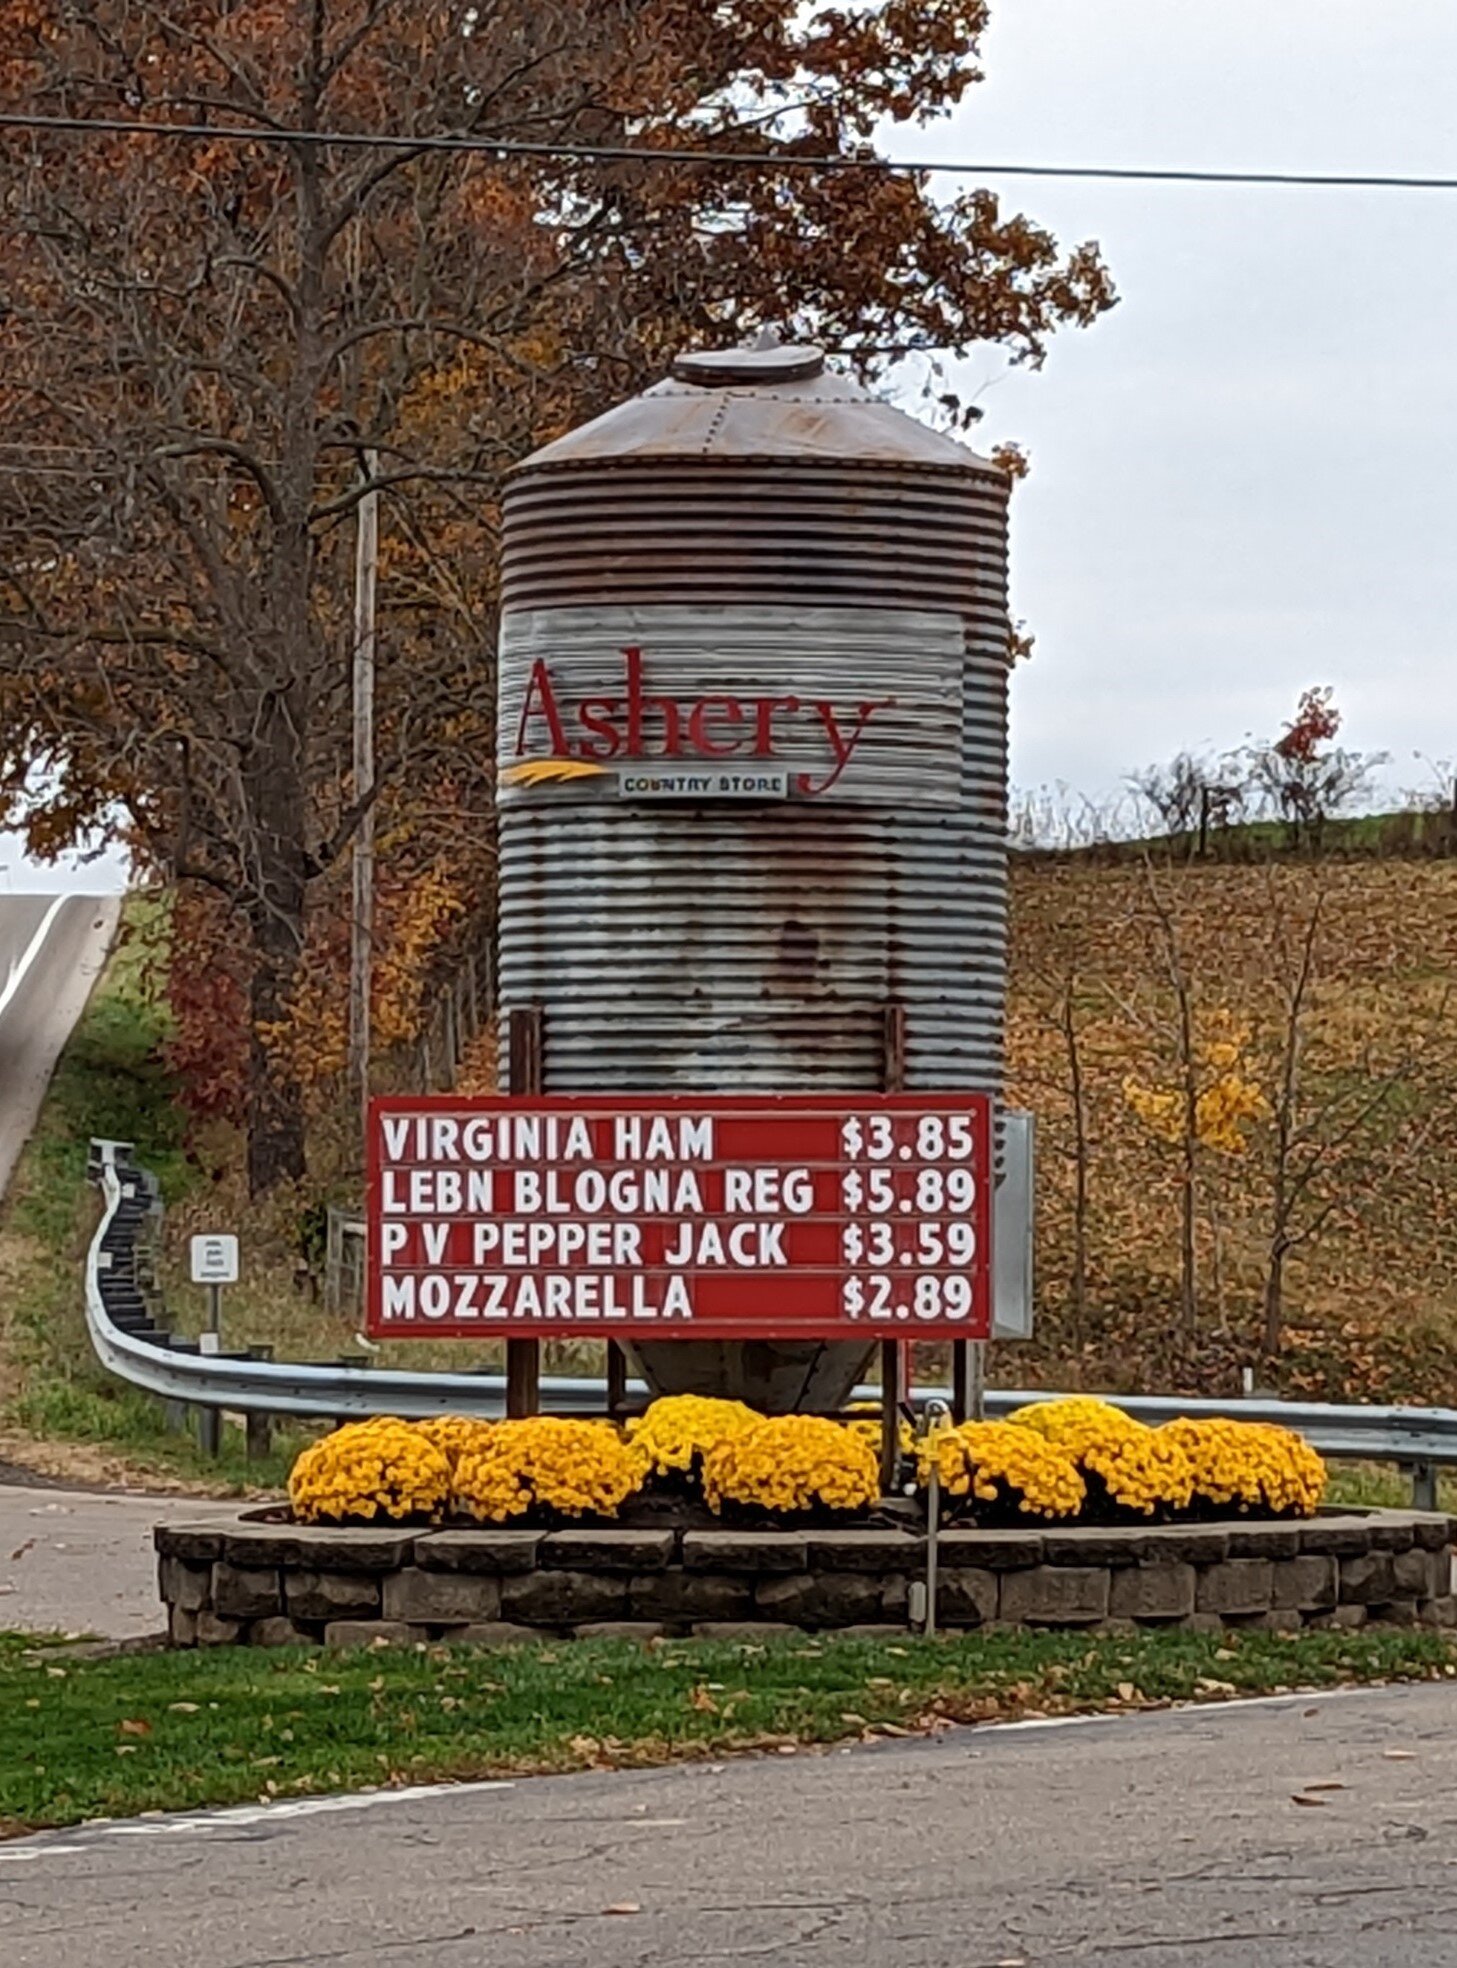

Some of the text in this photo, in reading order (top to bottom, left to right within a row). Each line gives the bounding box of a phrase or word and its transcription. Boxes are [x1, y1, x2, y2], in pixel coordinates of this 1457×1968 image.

[513, 645, 898, 794] Ashery
[624, 776, 782, 792] COUNTRY STORE
[381, 1115, 974, 1162] VIRGINIA HAM $3.85
[381, 1168, 977, 1214] LEBN BLOGNA REG $5.89
[380, 1222, 977, 1267] P V PEPPER JACK $3.59
[381, 1274, 973, 1320] MOZZARELLA $2.89
